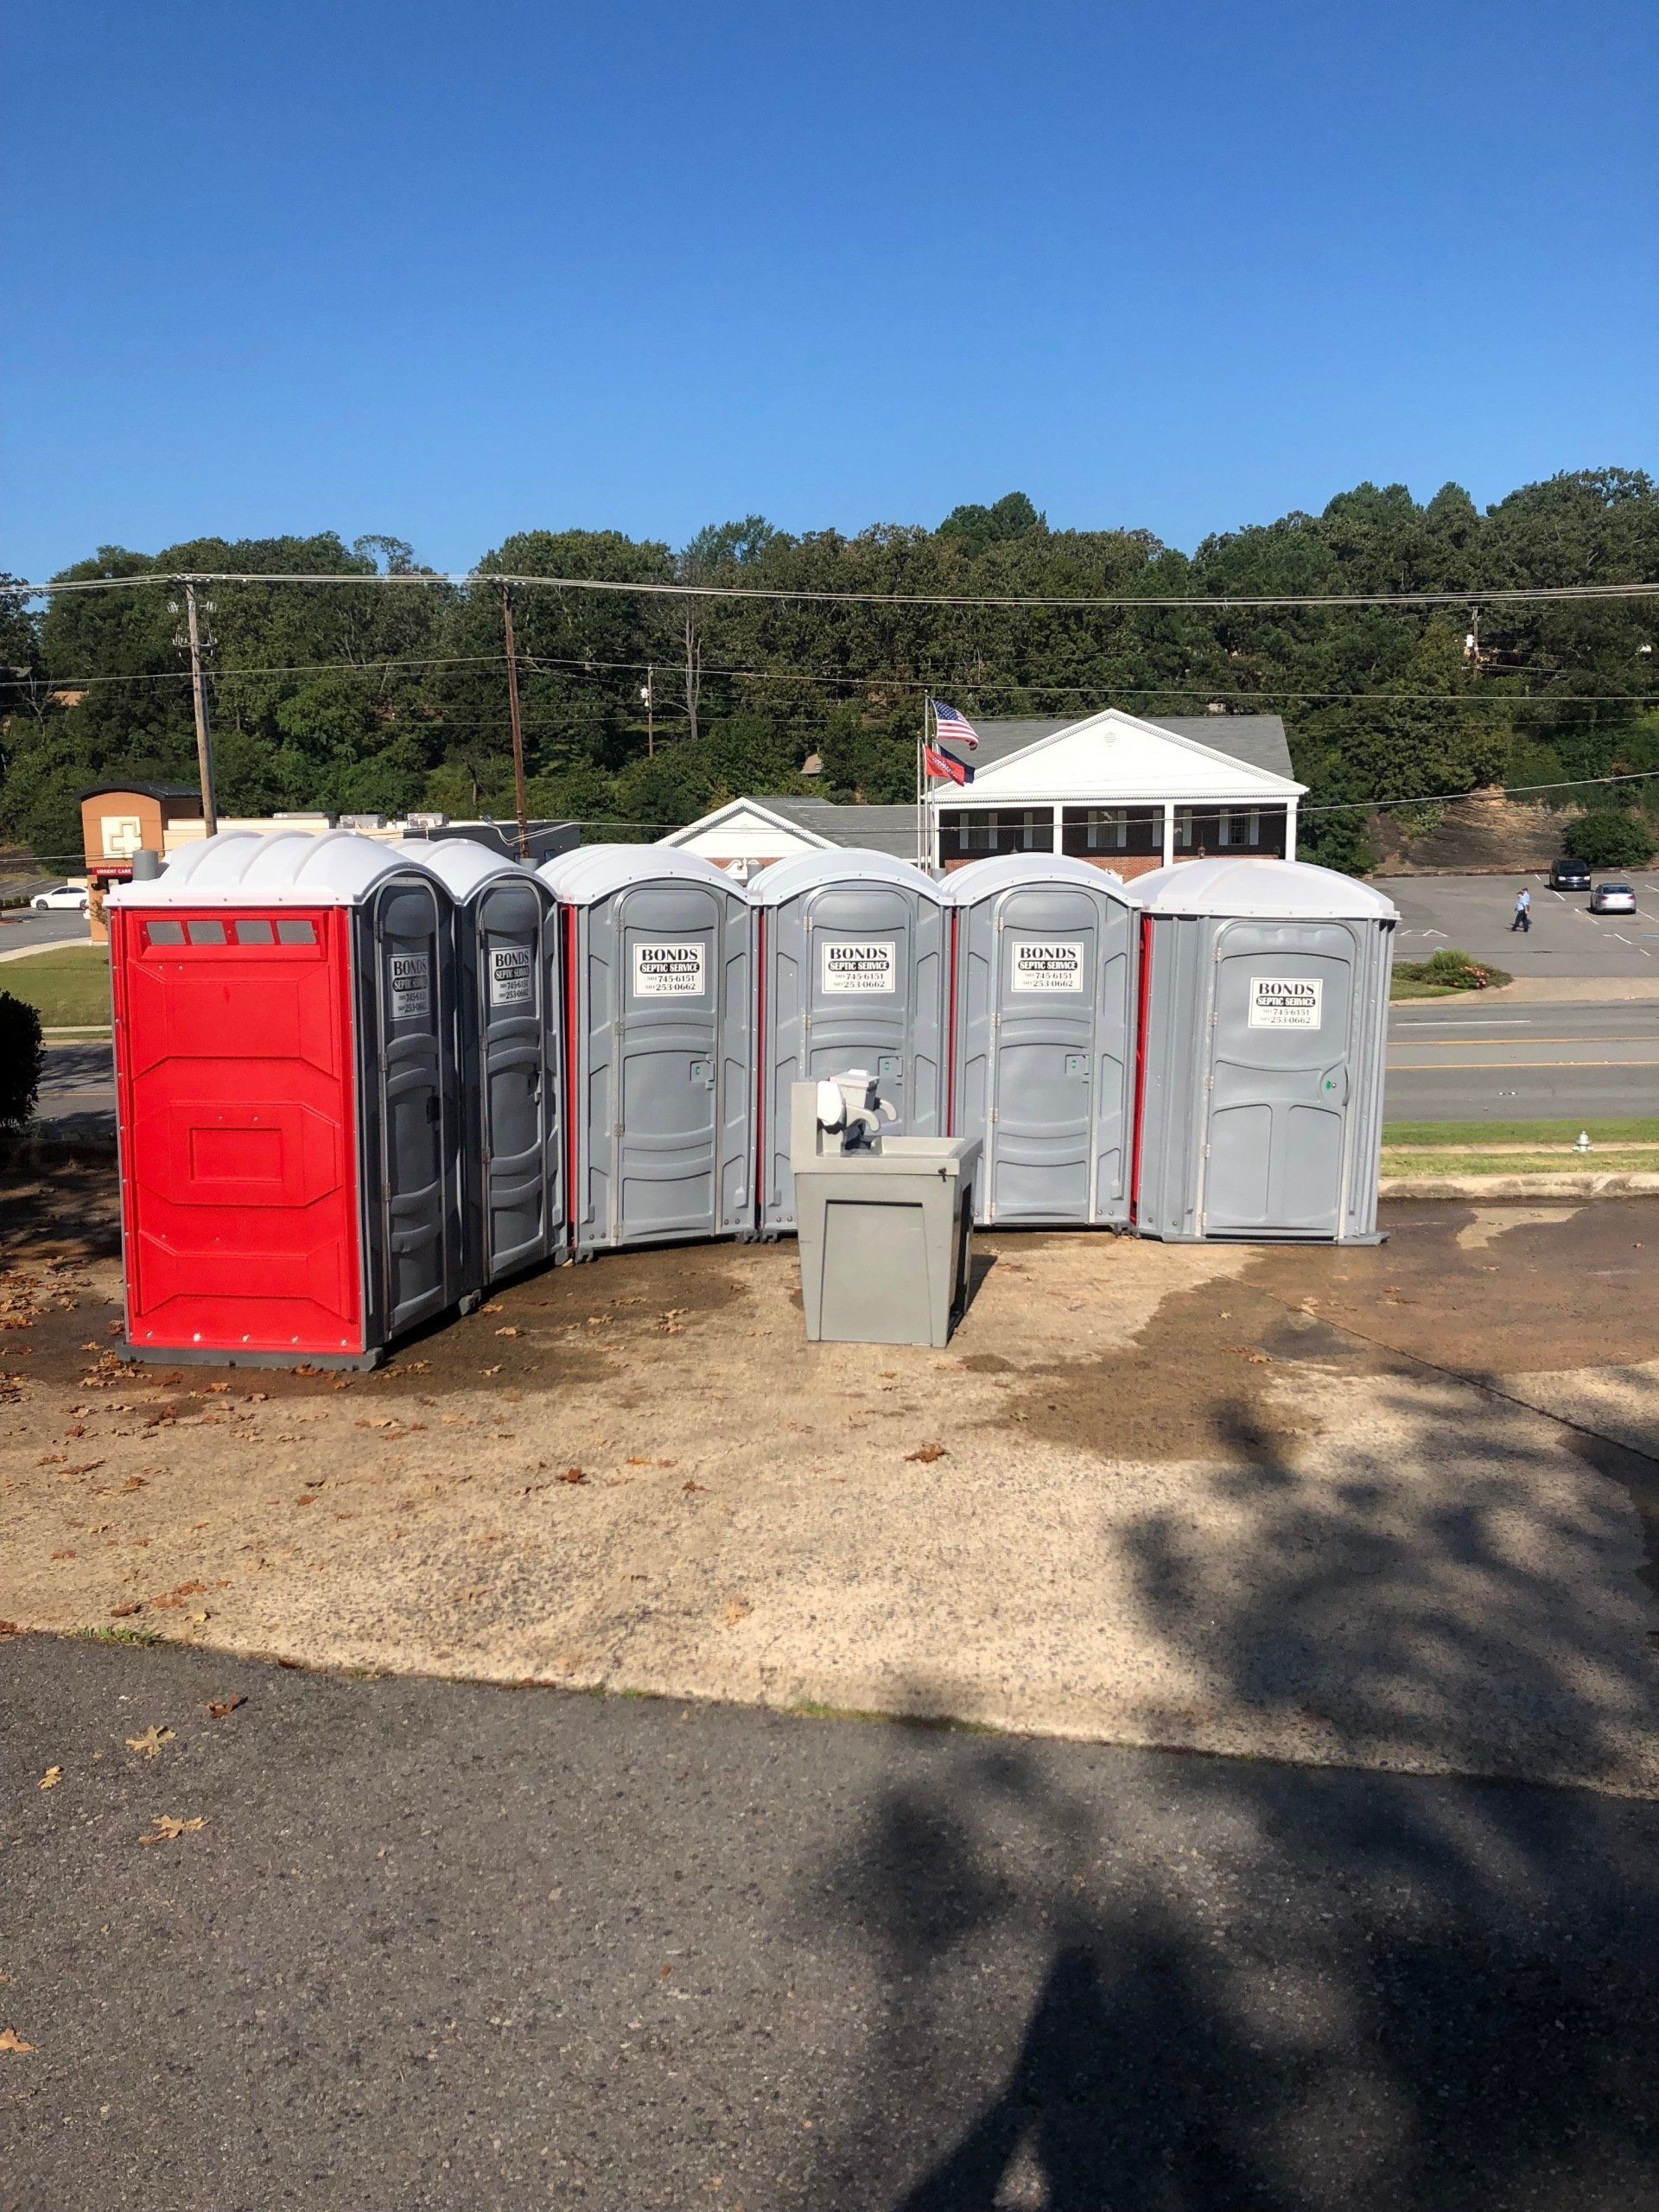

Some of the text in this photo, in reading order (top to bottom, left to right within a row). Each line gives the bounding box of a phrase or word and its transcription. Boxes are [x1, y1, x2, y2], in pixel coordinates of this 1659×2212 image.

[642, 948, 698, 961] BONDS
[830, 947, 887, 959] BONDS
[1020, 947, 1076, 958] BONDS
[495, 950, 529, 967] BONDS
[394, 958, 427, 976] BONDS
[641, 963, 698, 973] SEPTIC SERVICE
[830, 961, 888, 970] SEPTIC SERVICE
[1020, 961, 1077, 969] SEPTIC SERVICE
[1259, 983, 1314, 995] BONDS
[1257, 996, 1314, 1007] SEPTIC SERVICE
